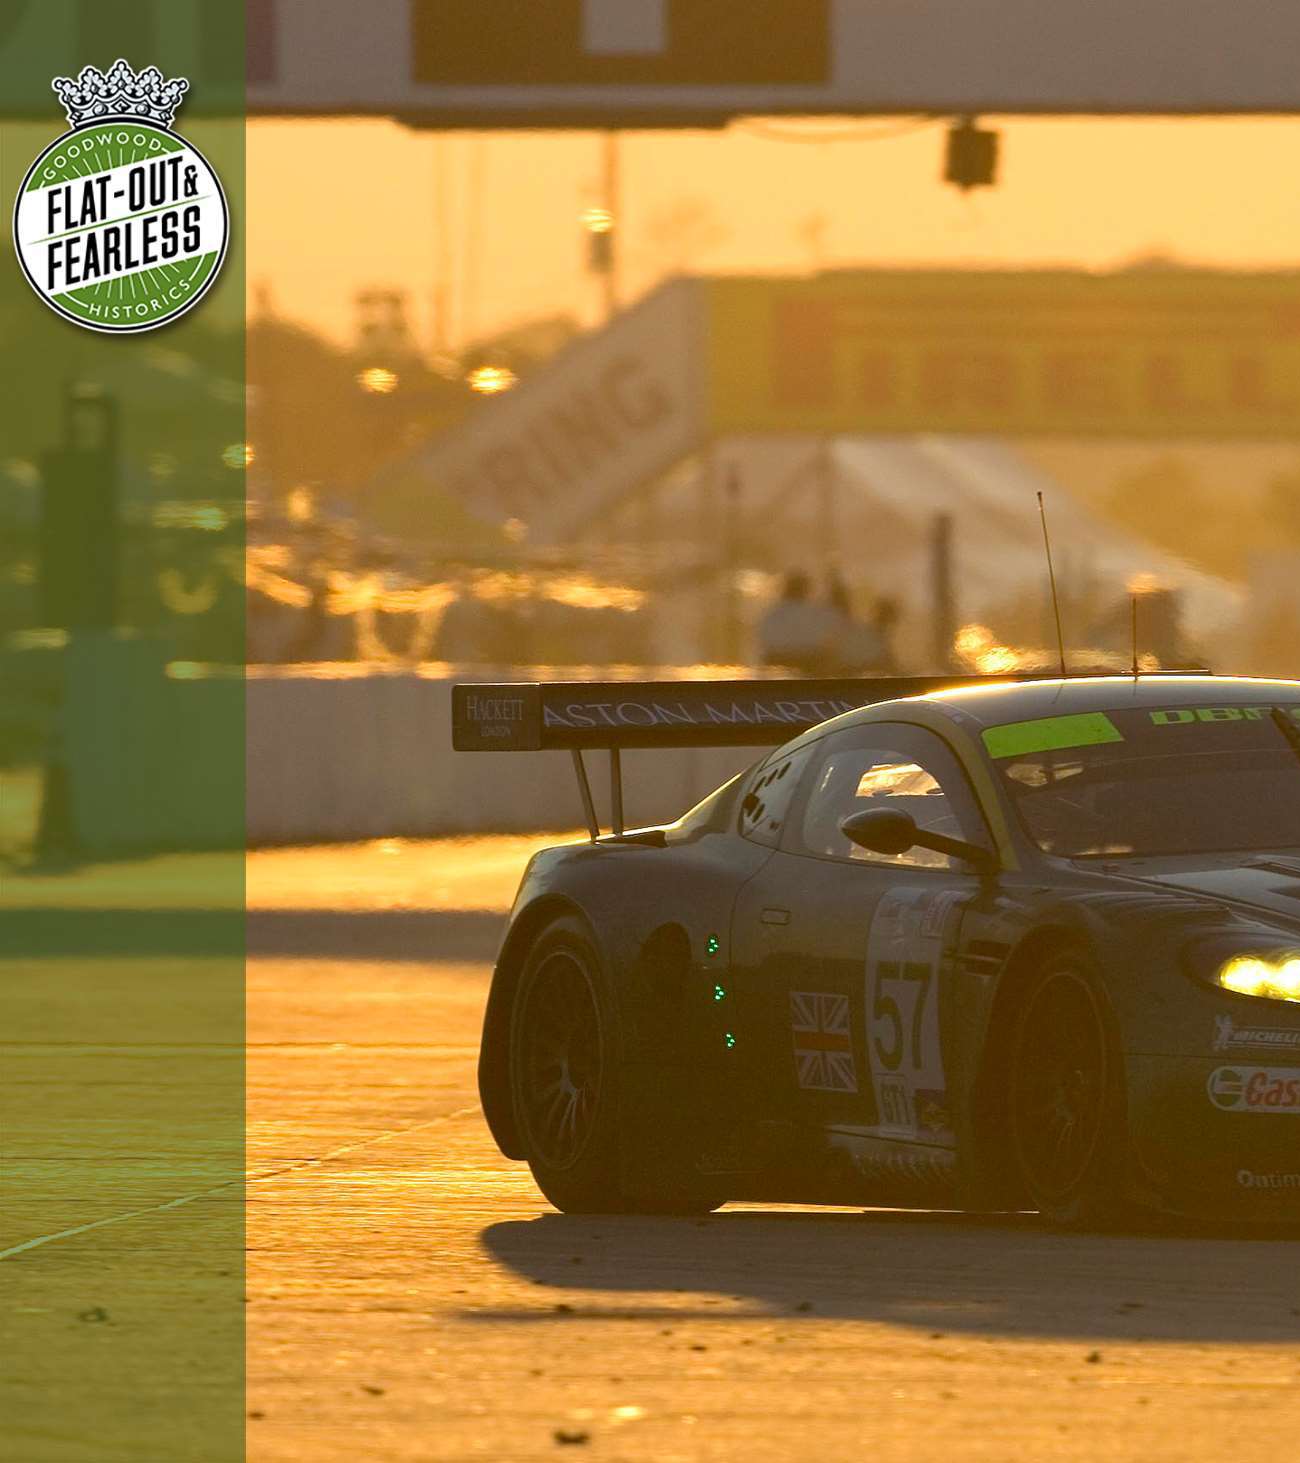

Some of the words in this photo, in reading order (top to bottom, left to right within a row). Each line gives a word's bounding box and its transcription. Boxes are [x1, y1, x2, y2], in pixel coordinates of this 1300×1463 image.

[466, 696, 525, 721] HACKETT
[543, 702, 697, 728] ASTON
[874, 960, 932, 1071] 57
